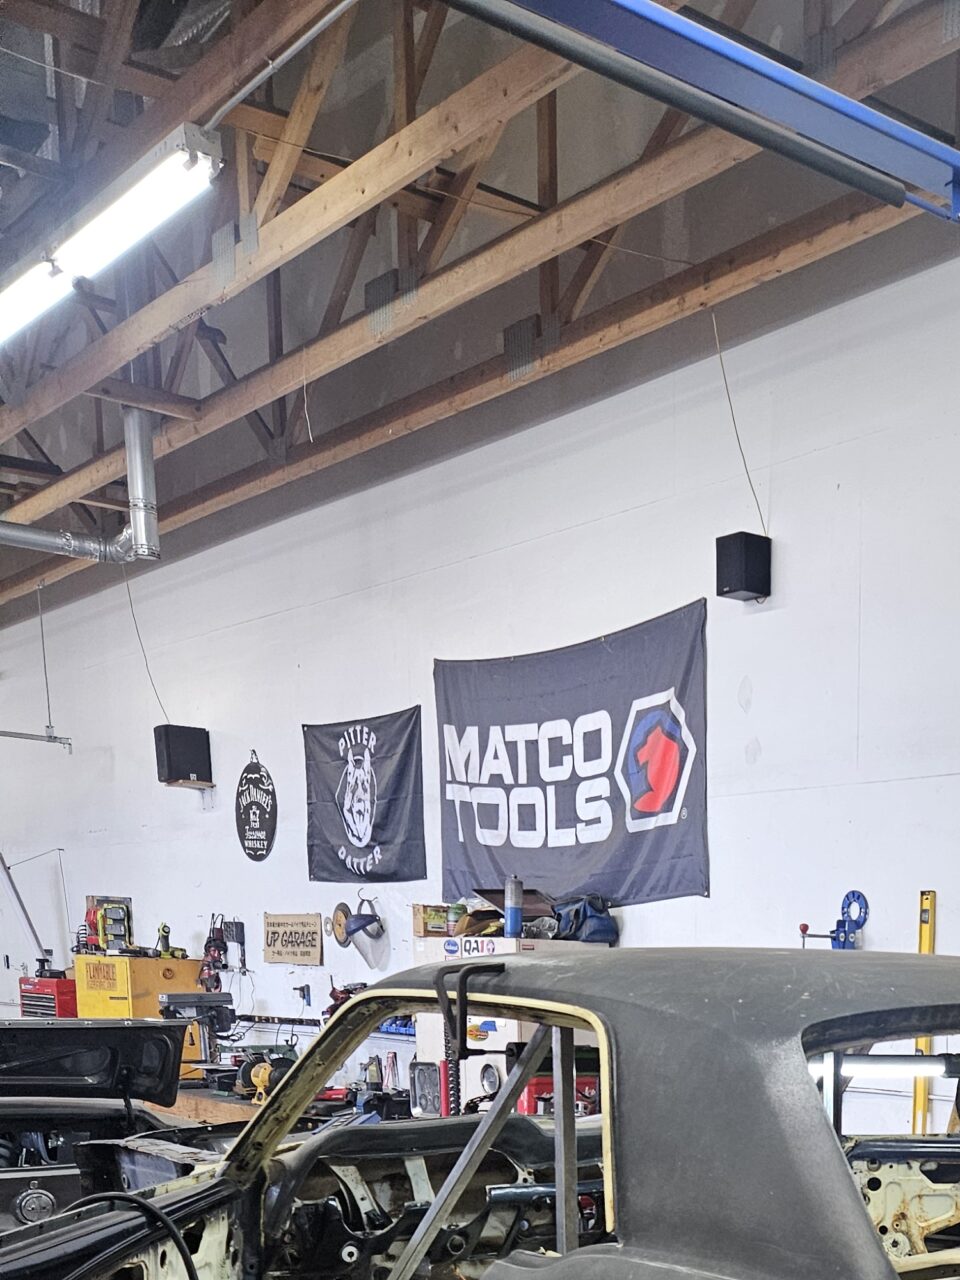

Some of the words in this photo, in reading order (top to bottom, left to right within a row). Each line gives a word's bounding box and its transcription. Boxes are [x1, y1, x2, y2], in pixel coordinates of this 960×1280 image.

[338, 724, 377, 757] PITTER
[443, 709, 612, 785] MATCO
[445, 776, 613, 848] TOOLS
[244, 840, 268, 849] WHISKEY
[338, 845, 382, 875] PATTER
[266, 930, 280, 948] UP
[281, 930, 318, 948] GARAGE
